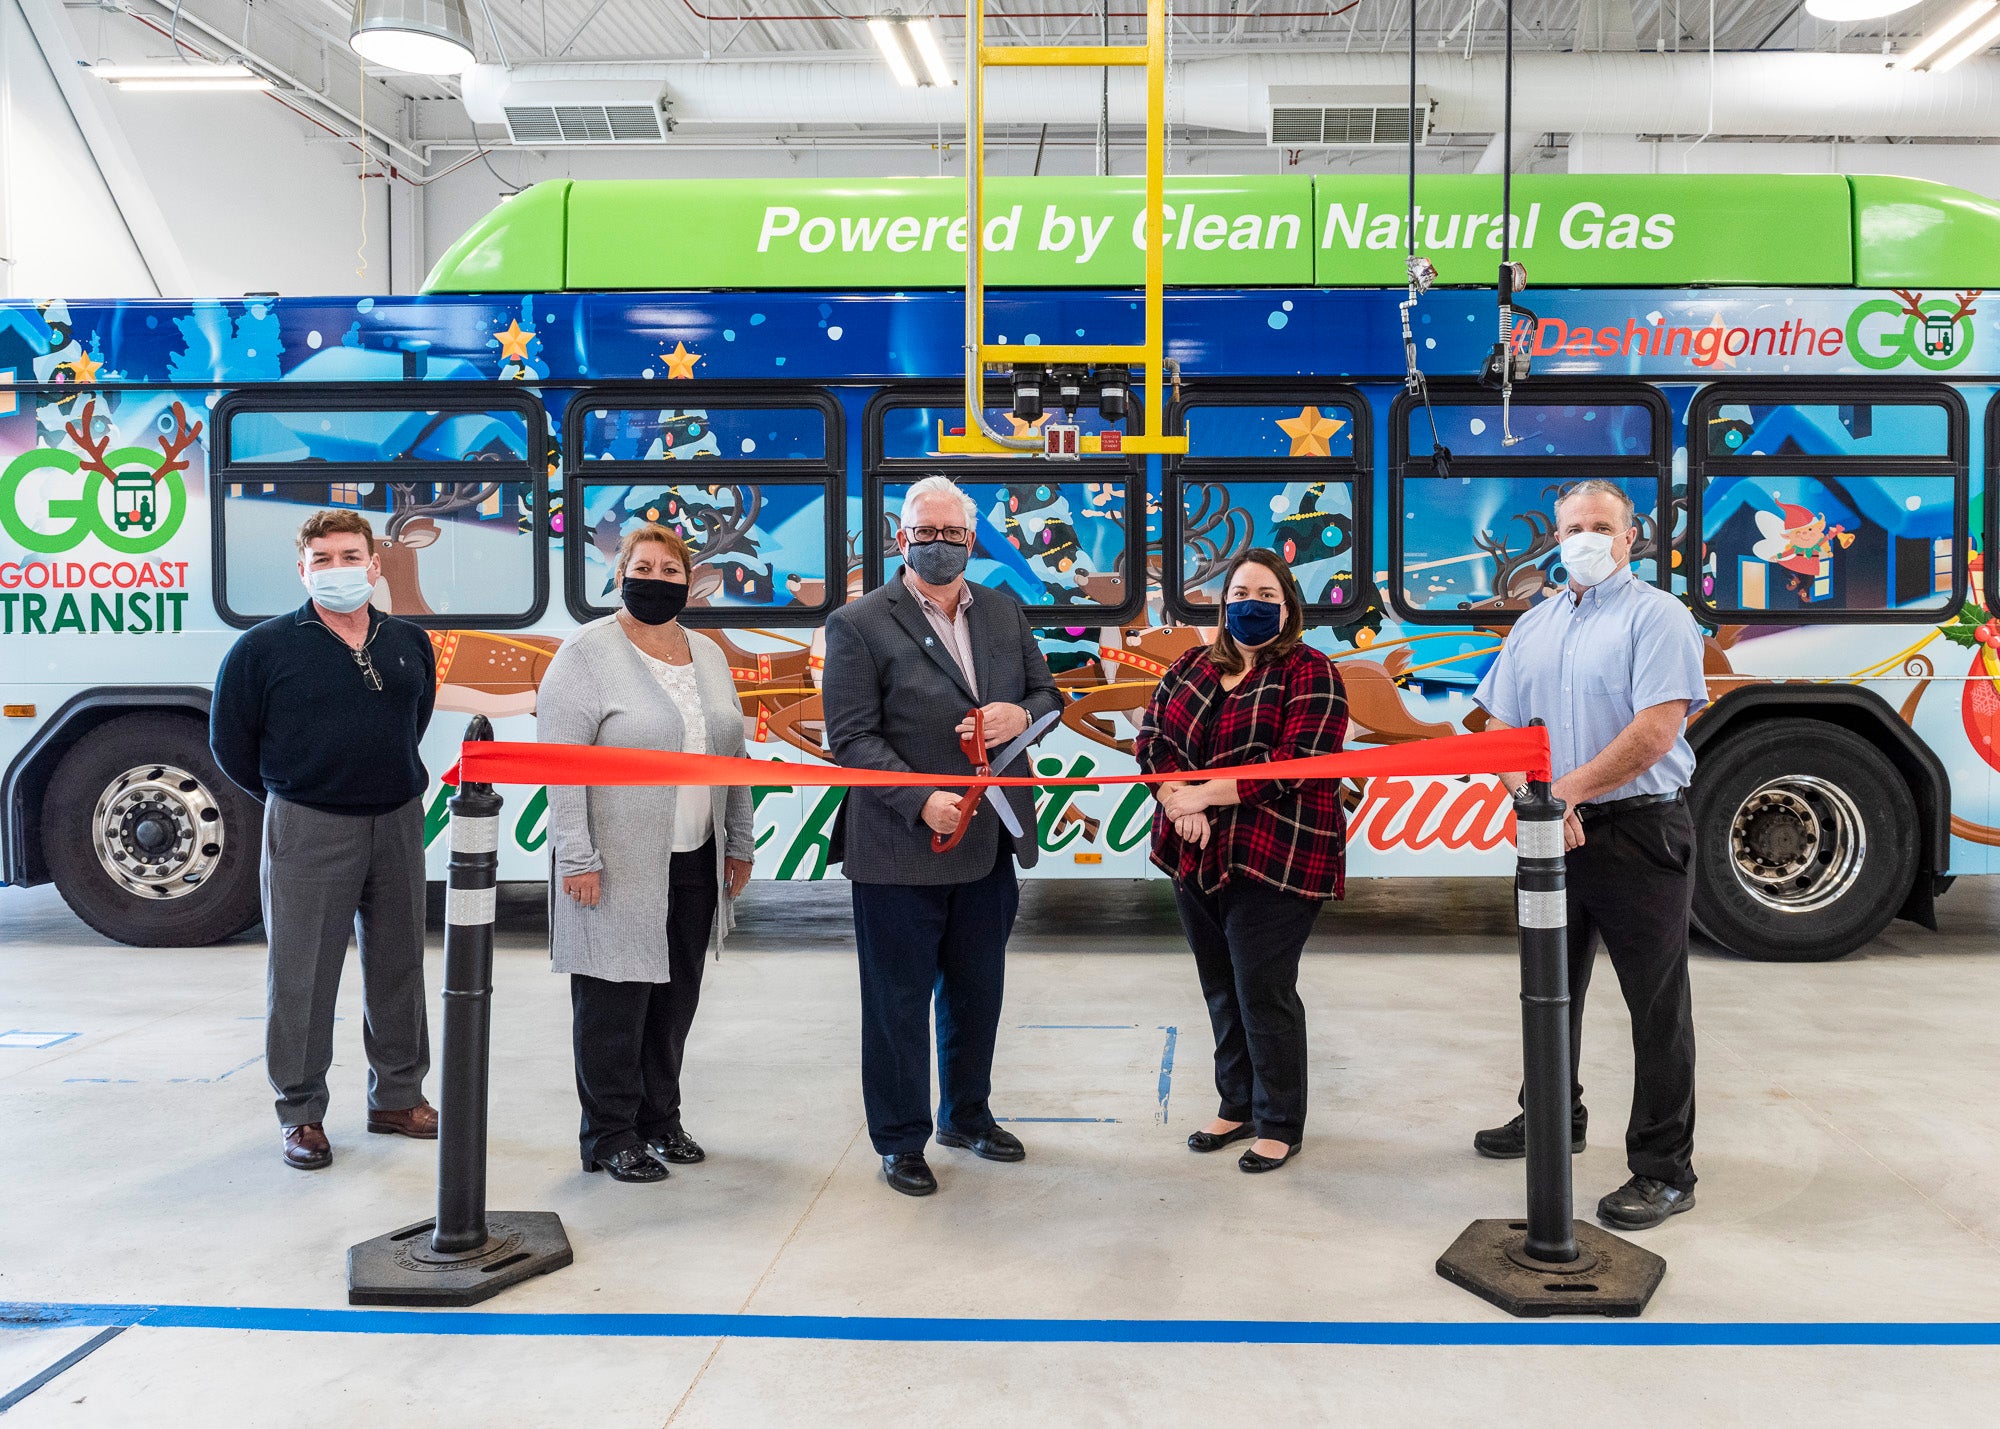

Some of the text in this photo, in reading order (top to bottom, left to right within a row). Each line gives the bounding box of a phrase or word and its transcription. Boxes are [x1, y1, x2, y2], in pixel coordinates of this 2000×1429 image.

[757, 201, 1676, 264] Powered by Clean Natural Gas
[0, 446, 187, 554] GO
[0, 592, 189, 634] TRANSIT
